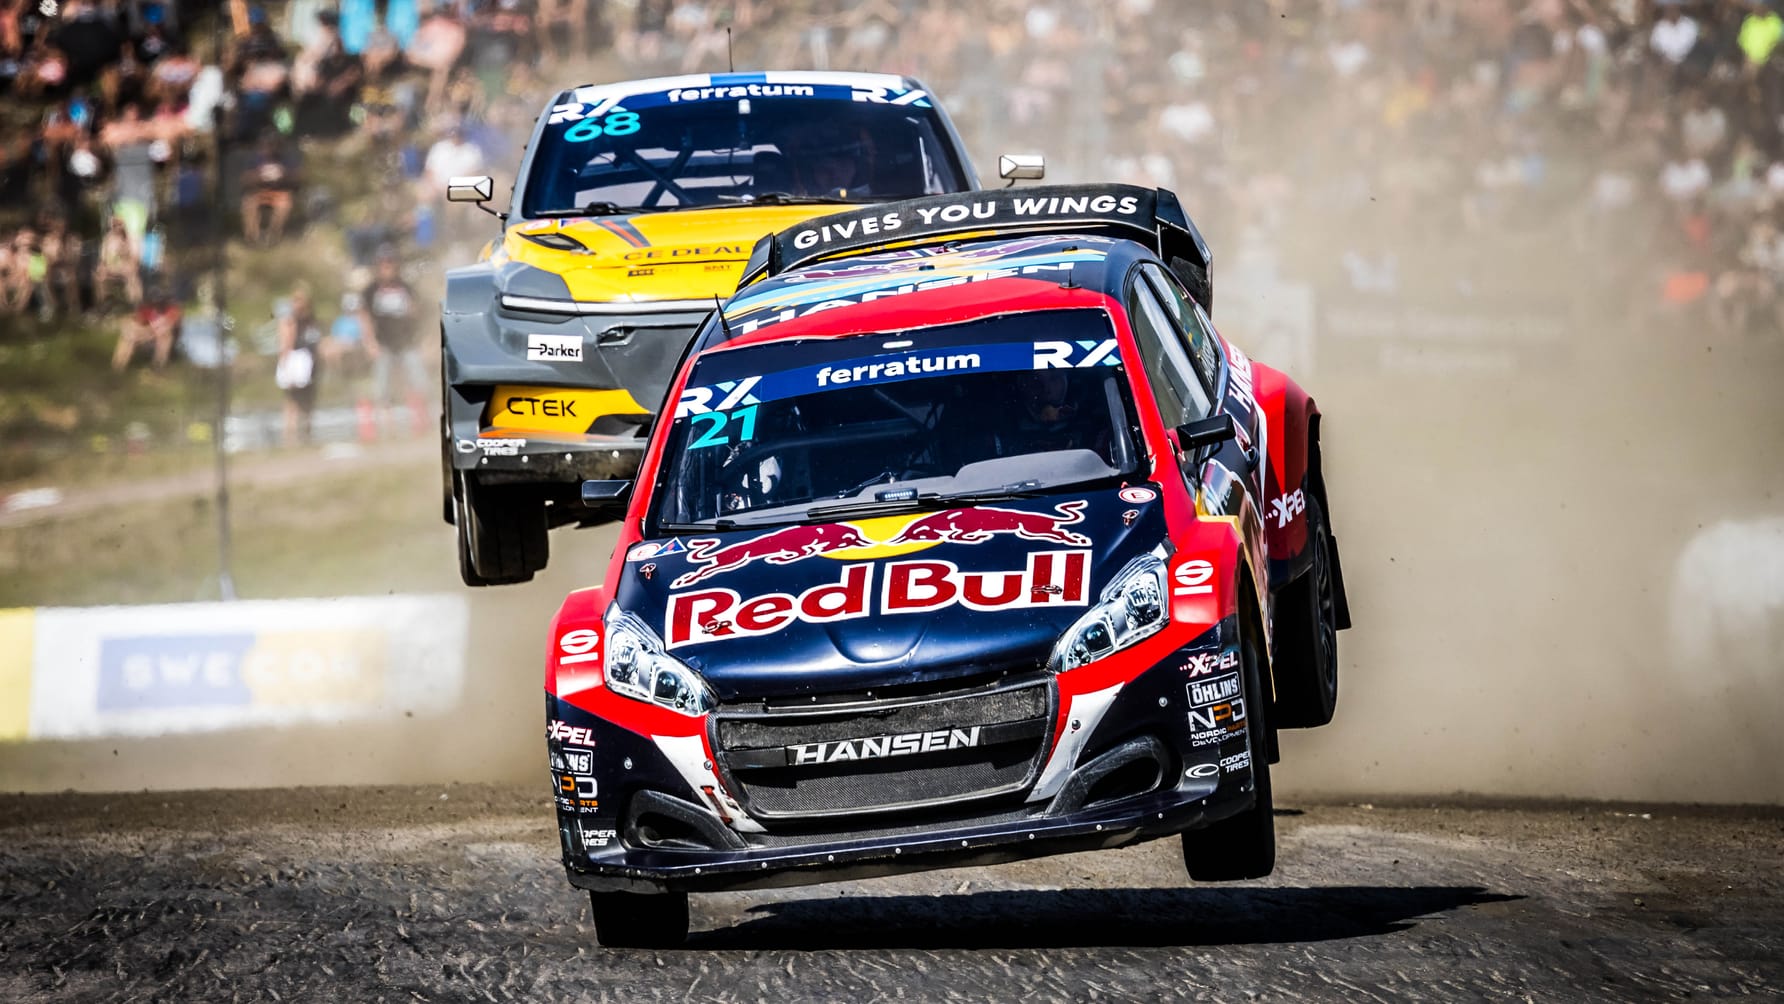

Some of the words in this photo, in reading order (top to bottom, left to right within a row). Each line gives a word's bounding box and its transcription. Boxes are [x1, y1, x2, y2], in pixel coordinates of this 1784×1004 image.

[668, 84, 815, 103] ferratum
[563, 111, 641, 143] 68
[793, 212, 902, 249] GIVES
[916, 200, 997, 226] YOU
[1013, 195, 1139, 217] WINGS
[671, 245, 750, 257] DEAL
[538, 343, 580, 357] Parker
[1032, 338, 1121, 371] RX
[815, 351, 981, 387] ferratum
[506, 397, 577, 418] CTEK
[673, 375, 763, 419] RX
[476, 438, 527, 448] COOPER
[687, 404, 759, 451] 21
[483, 447, 519, 456] TIRES
[665, 563, 876, 651] Red
[880, 550, 1093, 615] Bull
[1191, 677, 1239, 705] ÖHLINS
[1187, 698, 1246, 732] NPD
[795, 726, 982, 766] HANSEN
[1225, 759, 1250, 773] TIRES
